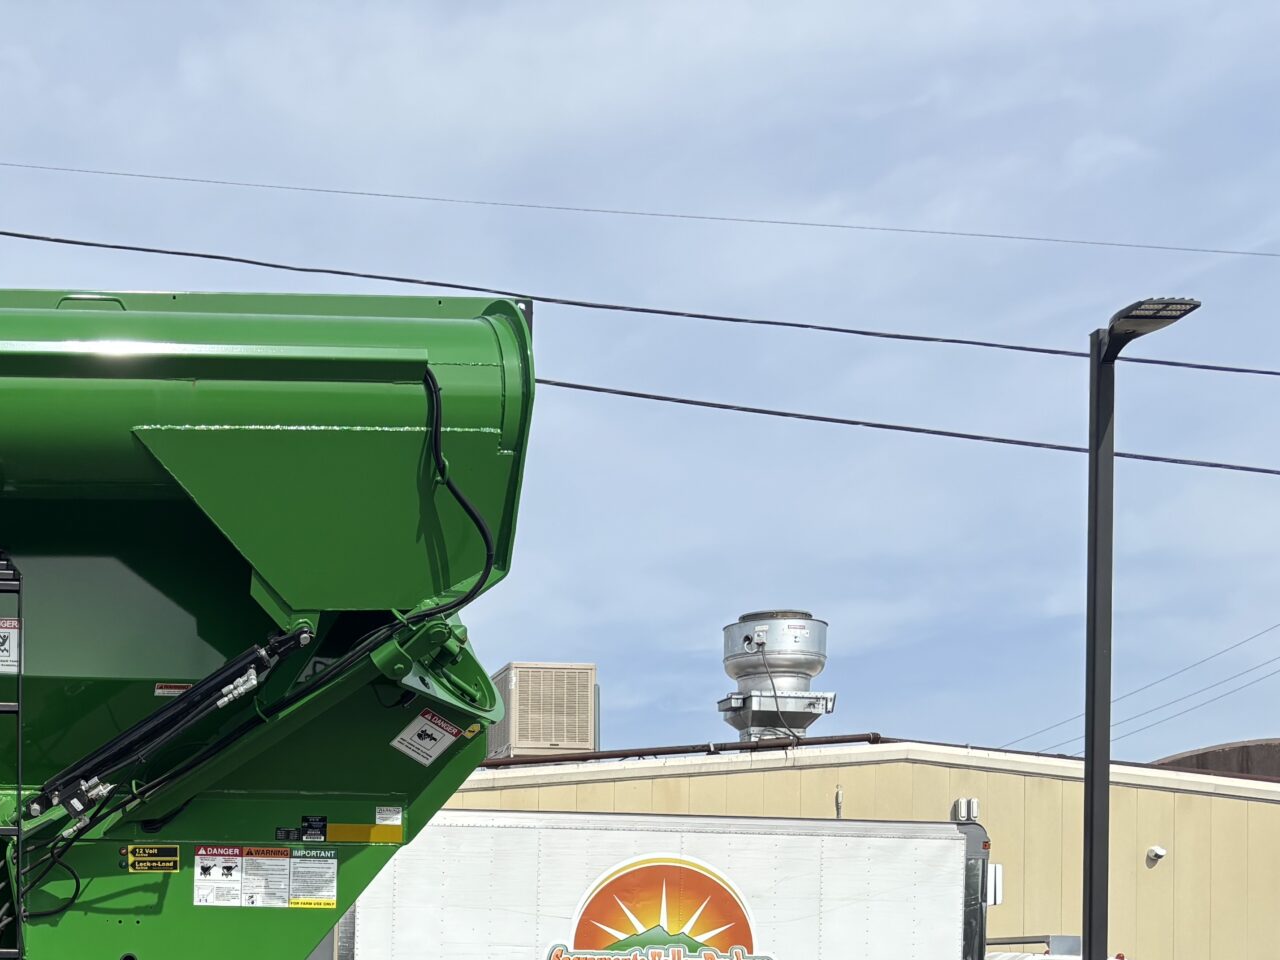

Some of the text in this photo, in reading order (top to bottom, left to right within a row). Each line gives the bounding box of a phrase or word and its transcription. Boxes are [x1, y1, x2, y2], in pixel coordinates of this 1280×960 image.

[431, 716, 459, 735] DANGER
[207, 847, 240, 855] DANGER
[254, 849, 289, 857] WARNING
[292, 850, 336, 858] IMPORTANT
